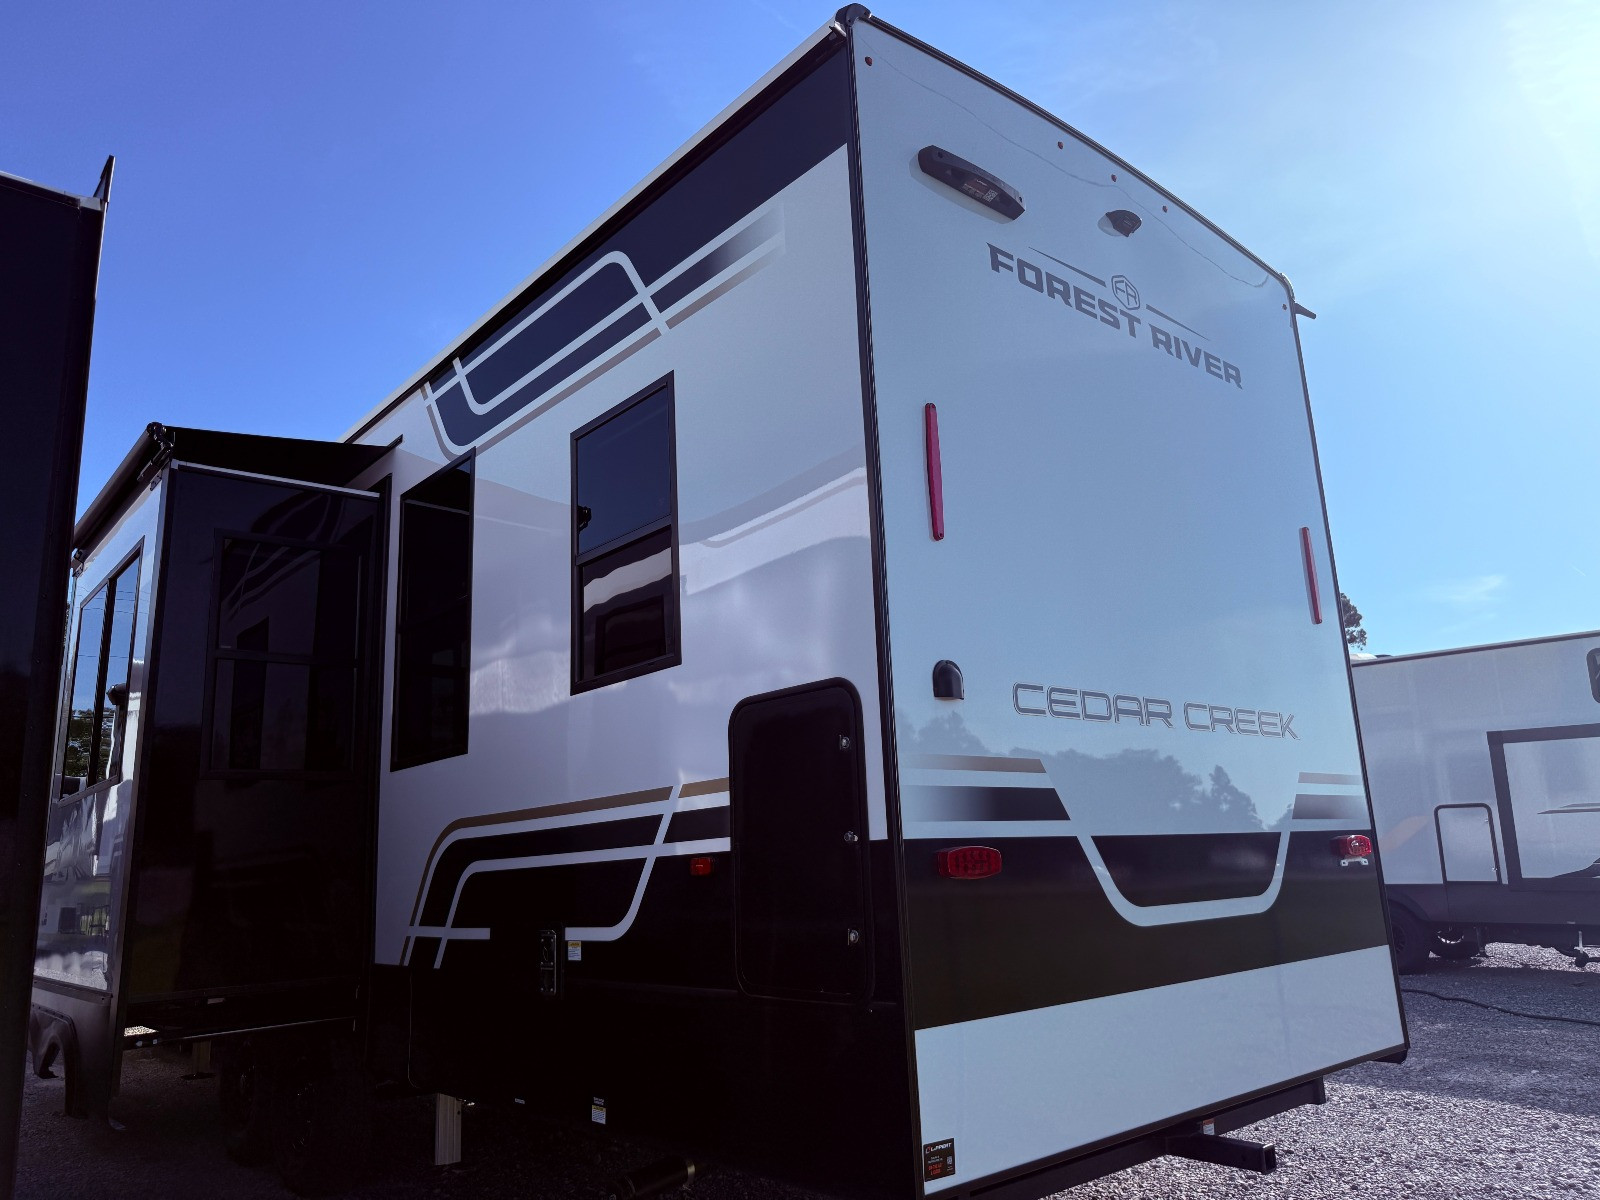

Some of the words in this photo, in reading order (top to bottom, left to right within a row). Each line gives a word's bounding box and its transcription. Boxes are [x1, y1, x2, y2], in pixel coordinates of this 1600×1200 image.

[986, 242, 1141, 338] FOREST
[1148, 323, 1243, 389] RIVER
[1013, 682, 1174, 728] CEDAR
[1183, 702, 1299, 739] CREEK
